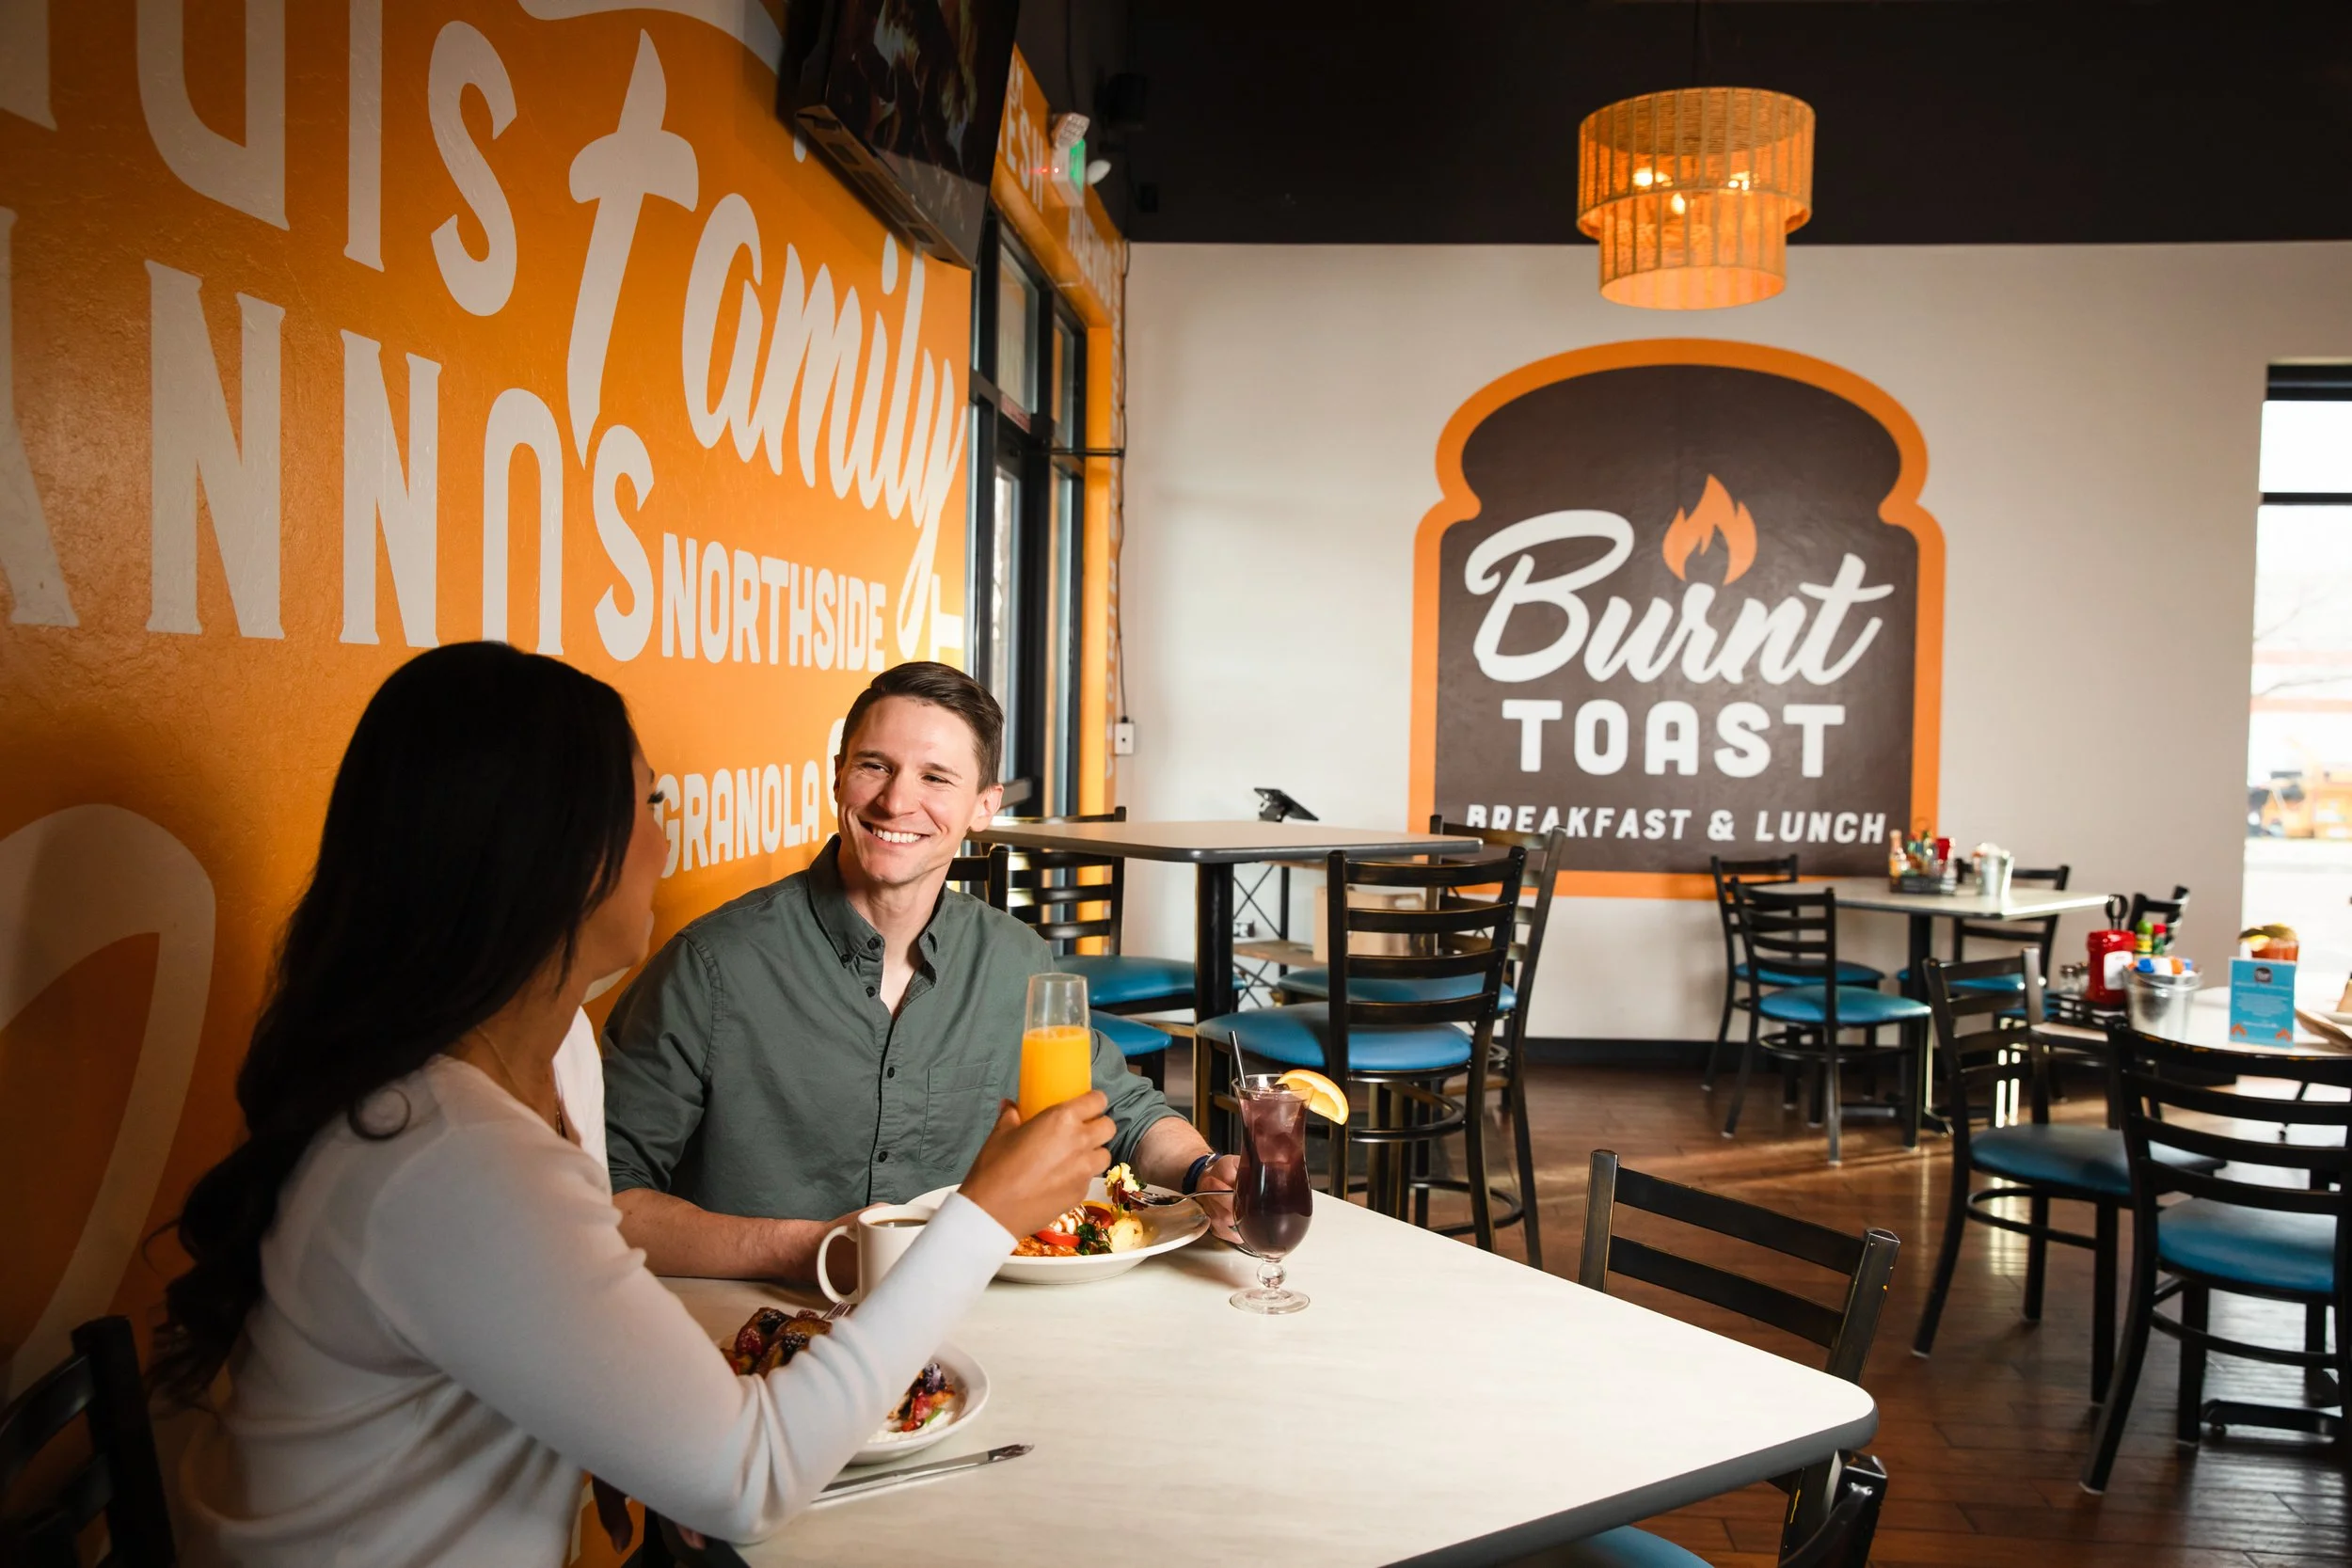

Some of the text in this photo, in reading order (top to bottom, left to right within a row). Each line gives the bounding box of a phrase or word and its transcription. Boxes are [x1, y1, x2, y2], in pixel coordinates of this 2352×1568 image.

[661, 532, 887, 673] NORTHSIDE
[1464, 509, 1895, 685] Burnt
[1502, 699, 1846, 778] TOAST
[655, 760, 820, 879] GRANOLA
[1465, 804, 1886, 845] BREAKFAST & LUNCH
